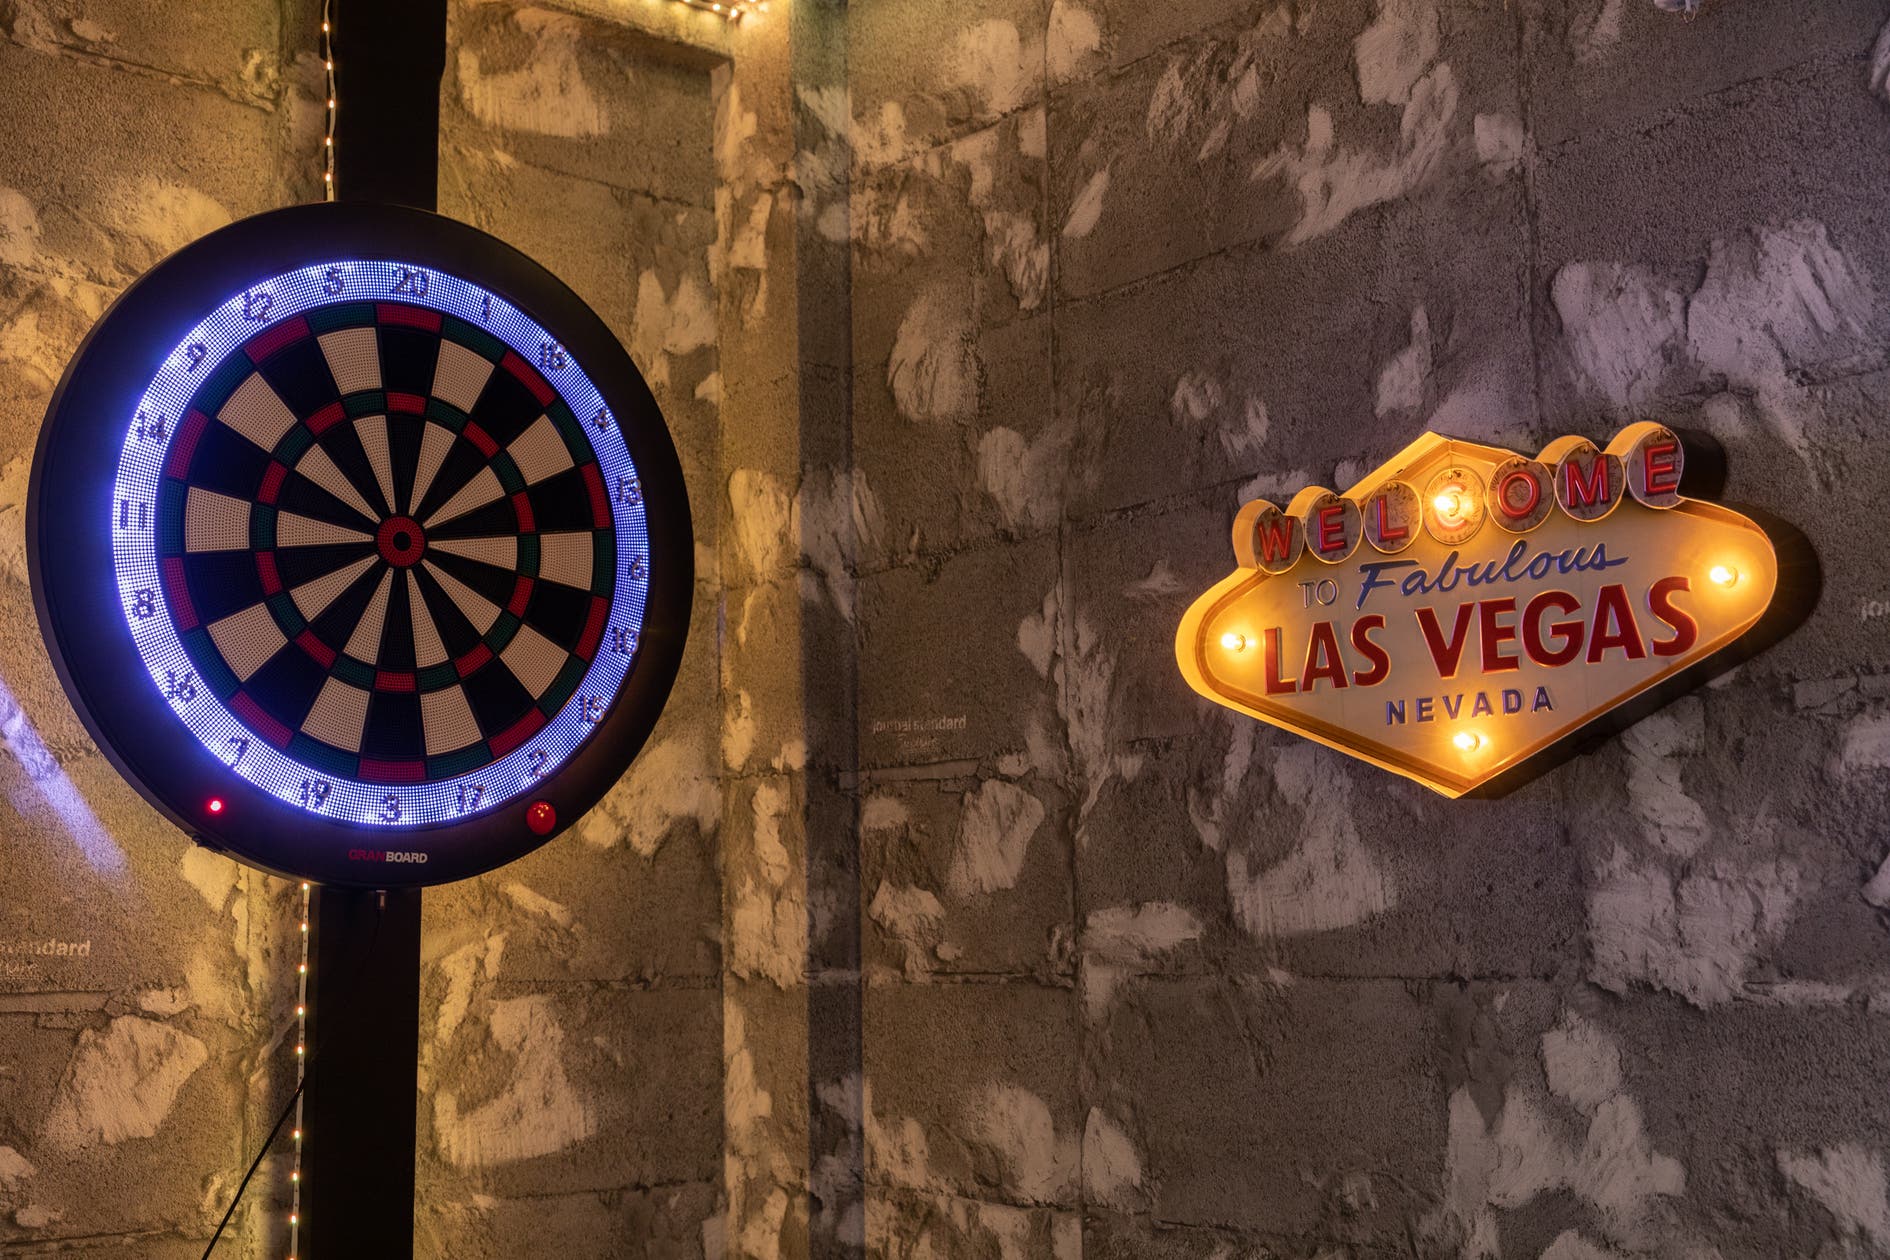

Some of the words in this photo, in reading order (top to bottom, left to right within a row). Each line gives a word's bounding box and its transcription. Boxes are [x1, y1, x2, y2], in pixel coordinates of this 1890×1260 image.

[326, 267, 344, 296] 5
[393, 265, 429, 298] 20
[243, 291, 273, 321] 12
[482, 293, 492, 321] 1
[186, 342, 206, 373] 9
[541, 342, 567, 370] 18
[136, 411, 166, 444] 14
[593, 408, 608, 432] 4
[617, 478, 642, 505] 13
[1257, 443, 1678, 564] WELCOME
[119, 500, 147, 529] 11
[631, 555, 646, 581] 6
[1298, 578, 1338, 609] TO
[1357, 540, 1629, 610] Fabulous
[132, 587, 155, 620] 8
[614, 628, 639, 654] 10
[1264, 615, 1391, 696] LAS
[1416, 577, 1698, 679] VEGAS
[167, 671, 196, 702] 16
[580, 697, 605, 723] 15
[1386, 686, 1554, 726] NEVADA
[229, 736, 248, 766] 7
[530, 750, 549, 776] 2
[301, 780, 332, 809] 19
[381, 794, 401, 822] 3
[457, 784, 485, 811] 17
[348, 849, 428, 864] GRANBOARD
